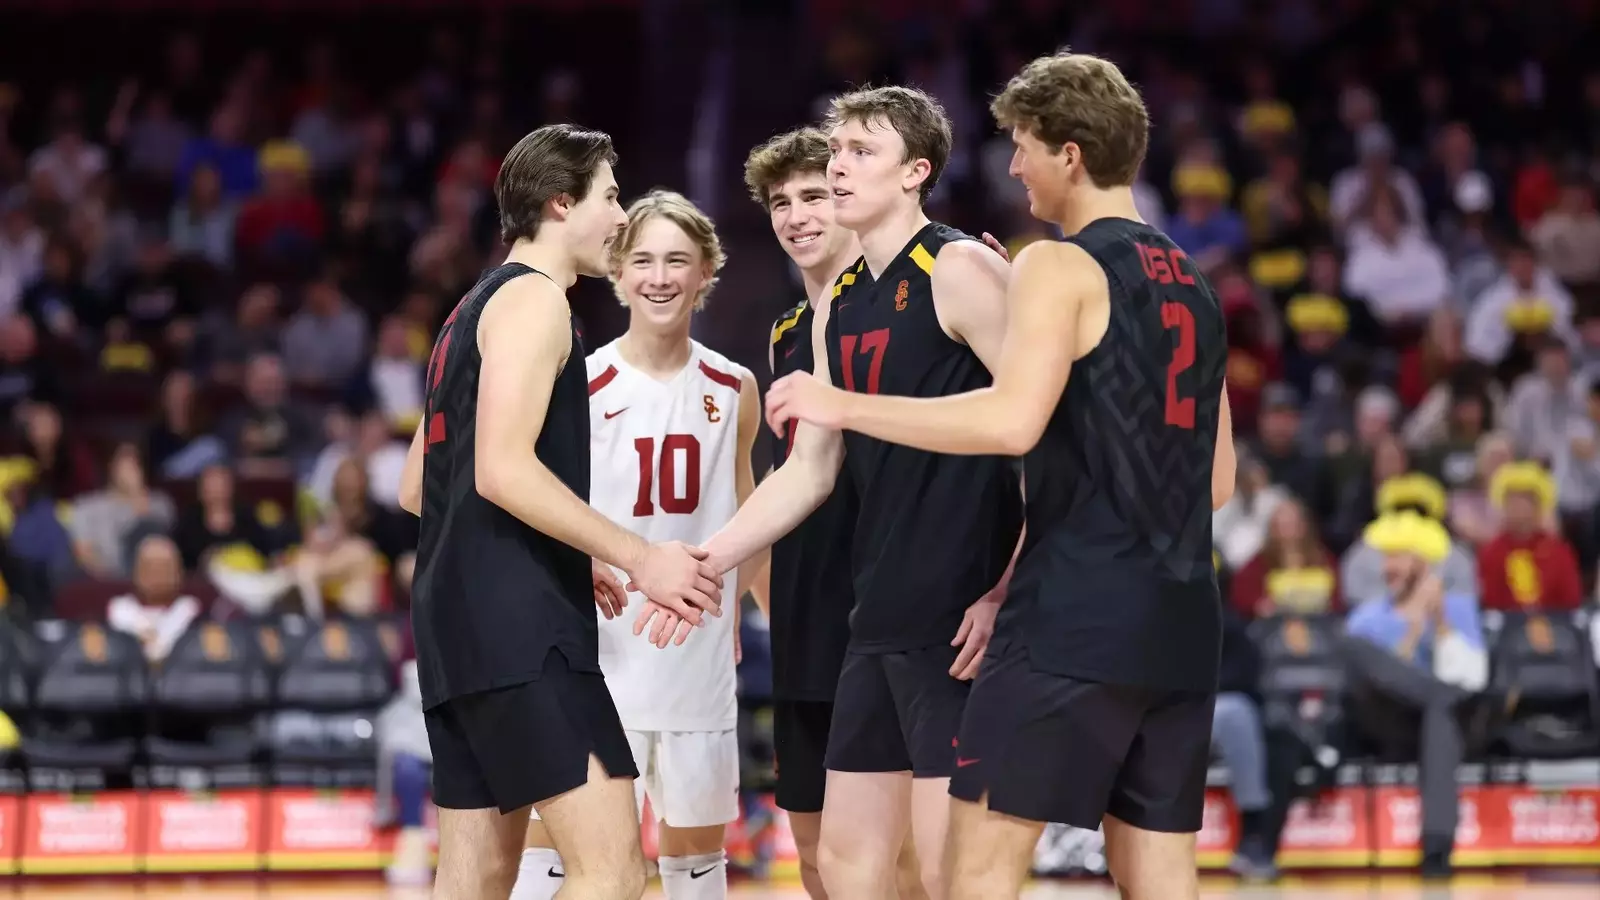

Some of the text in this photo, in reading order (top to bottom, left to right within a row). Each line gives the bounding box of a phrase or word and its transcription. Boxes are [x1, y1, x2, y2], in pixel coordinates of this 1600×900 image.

[1134, 242, 1195, 285] USC
[840, 327, 890, 396] 17
[1160, 301, 1196, 429] 2
[703, 394, 721, 423] SC
[632, 433, 701, 518] 10
